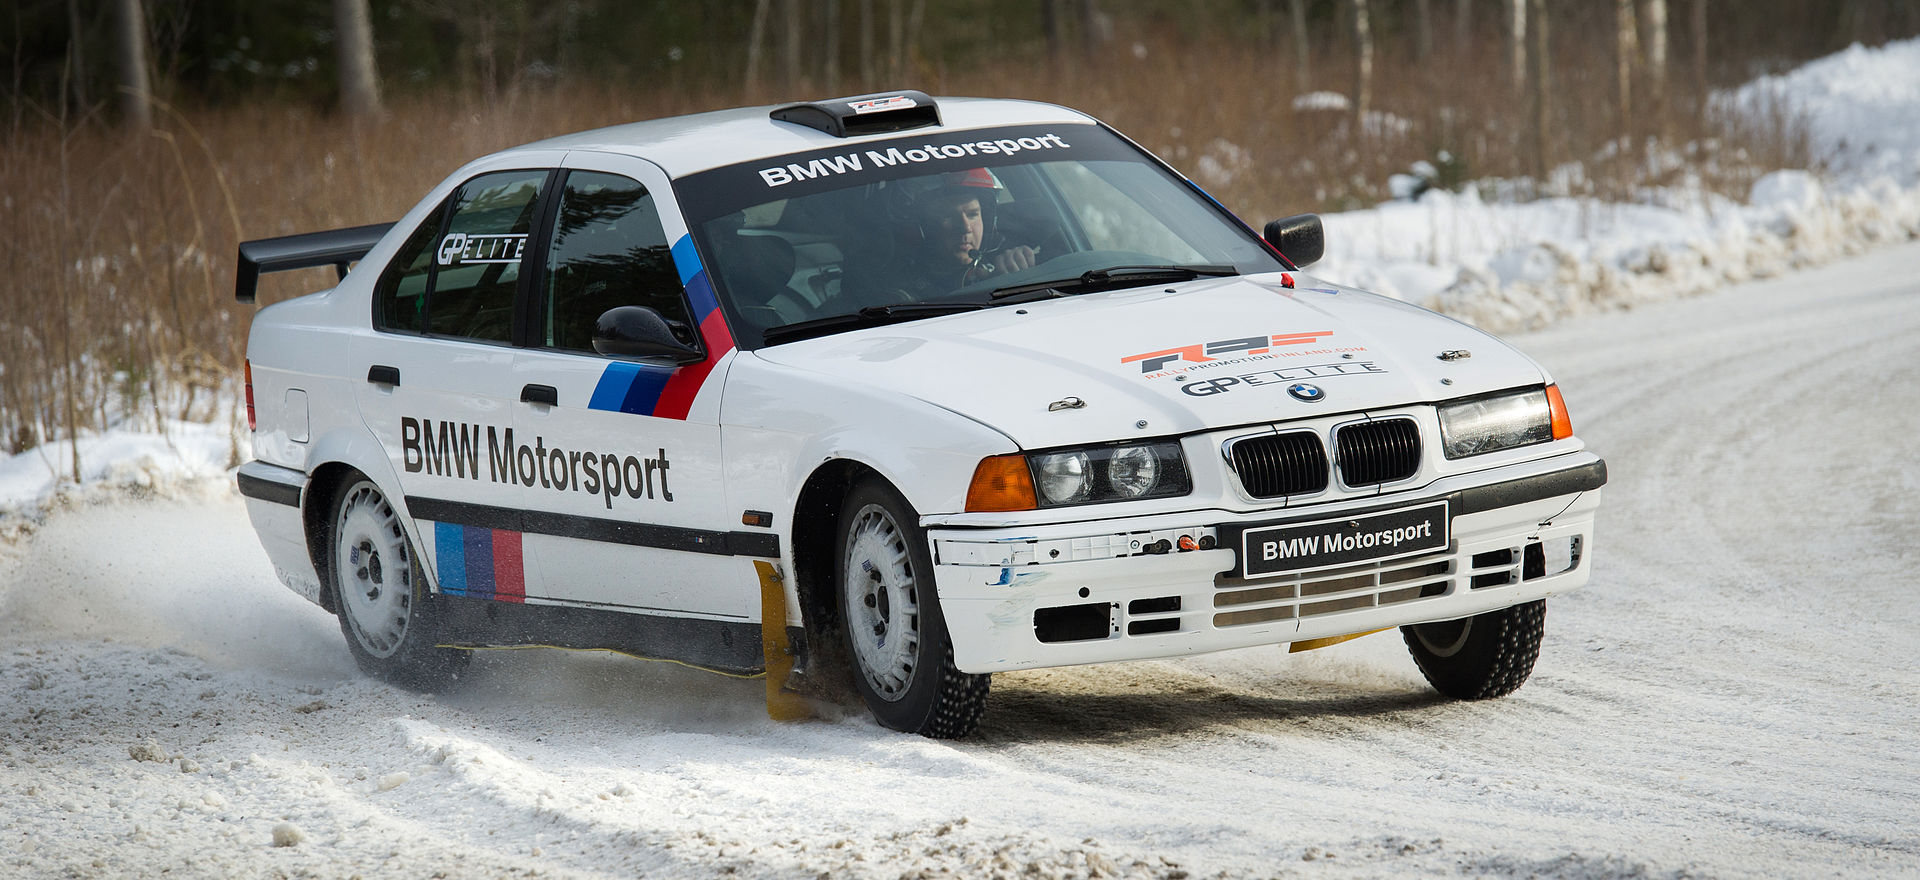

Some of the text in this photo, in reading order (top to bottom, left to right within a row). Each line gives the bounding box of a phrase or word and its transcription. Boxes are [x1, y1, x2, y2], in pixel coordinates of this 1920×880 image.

[758, 133, 1071, 188] BMW Motorsport
[401, 416, 674, 509] BMW Motorsport
[1263, 520, 1432, 561] BMW Motorsport
